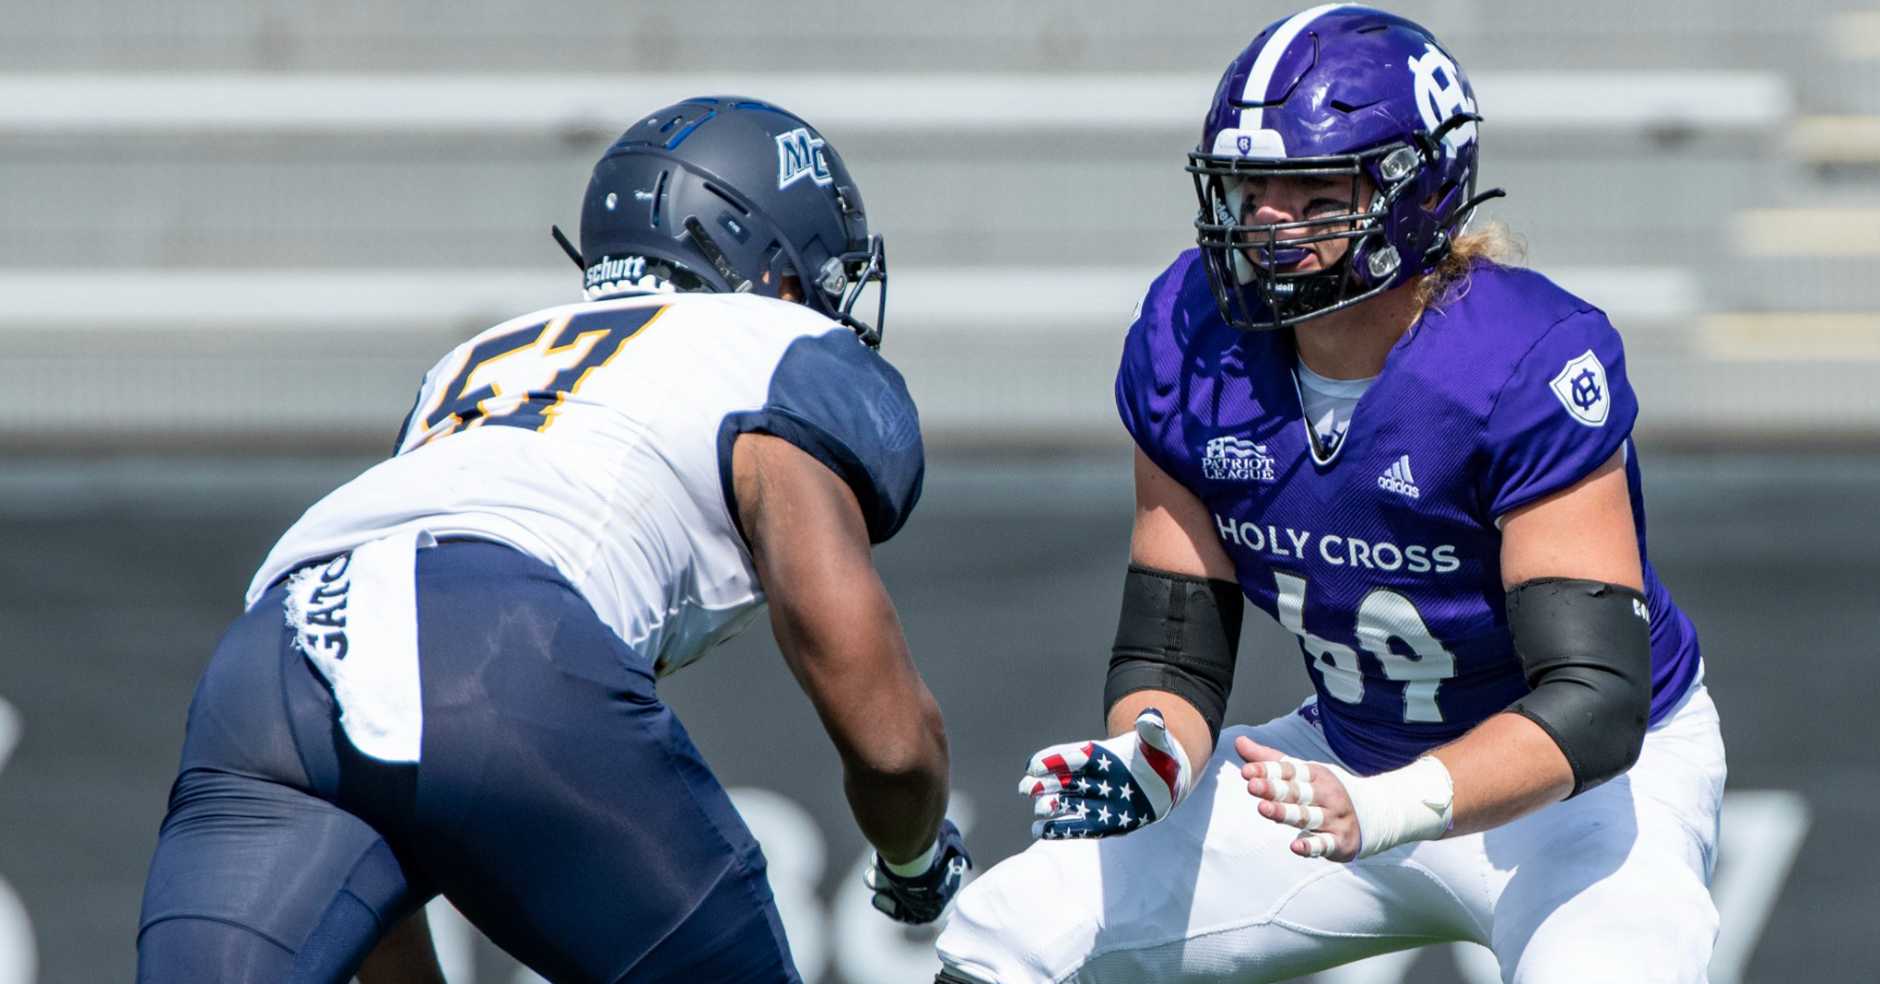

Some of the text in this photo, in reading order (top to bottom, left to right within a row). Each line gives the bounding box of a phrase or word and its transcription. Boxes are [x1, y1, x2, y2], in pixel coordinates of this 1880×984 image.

[586, 256, 646, 286] schutt
[421, 303, 672, 442] 57
[1201, 457, 1275, 470] PATRIOT
[1204, 468, 1274, 480] LEAGUE
[1378, 476, 1420, 498] adidas
[1215, 513, 1461, 573] HOLY CROSS
